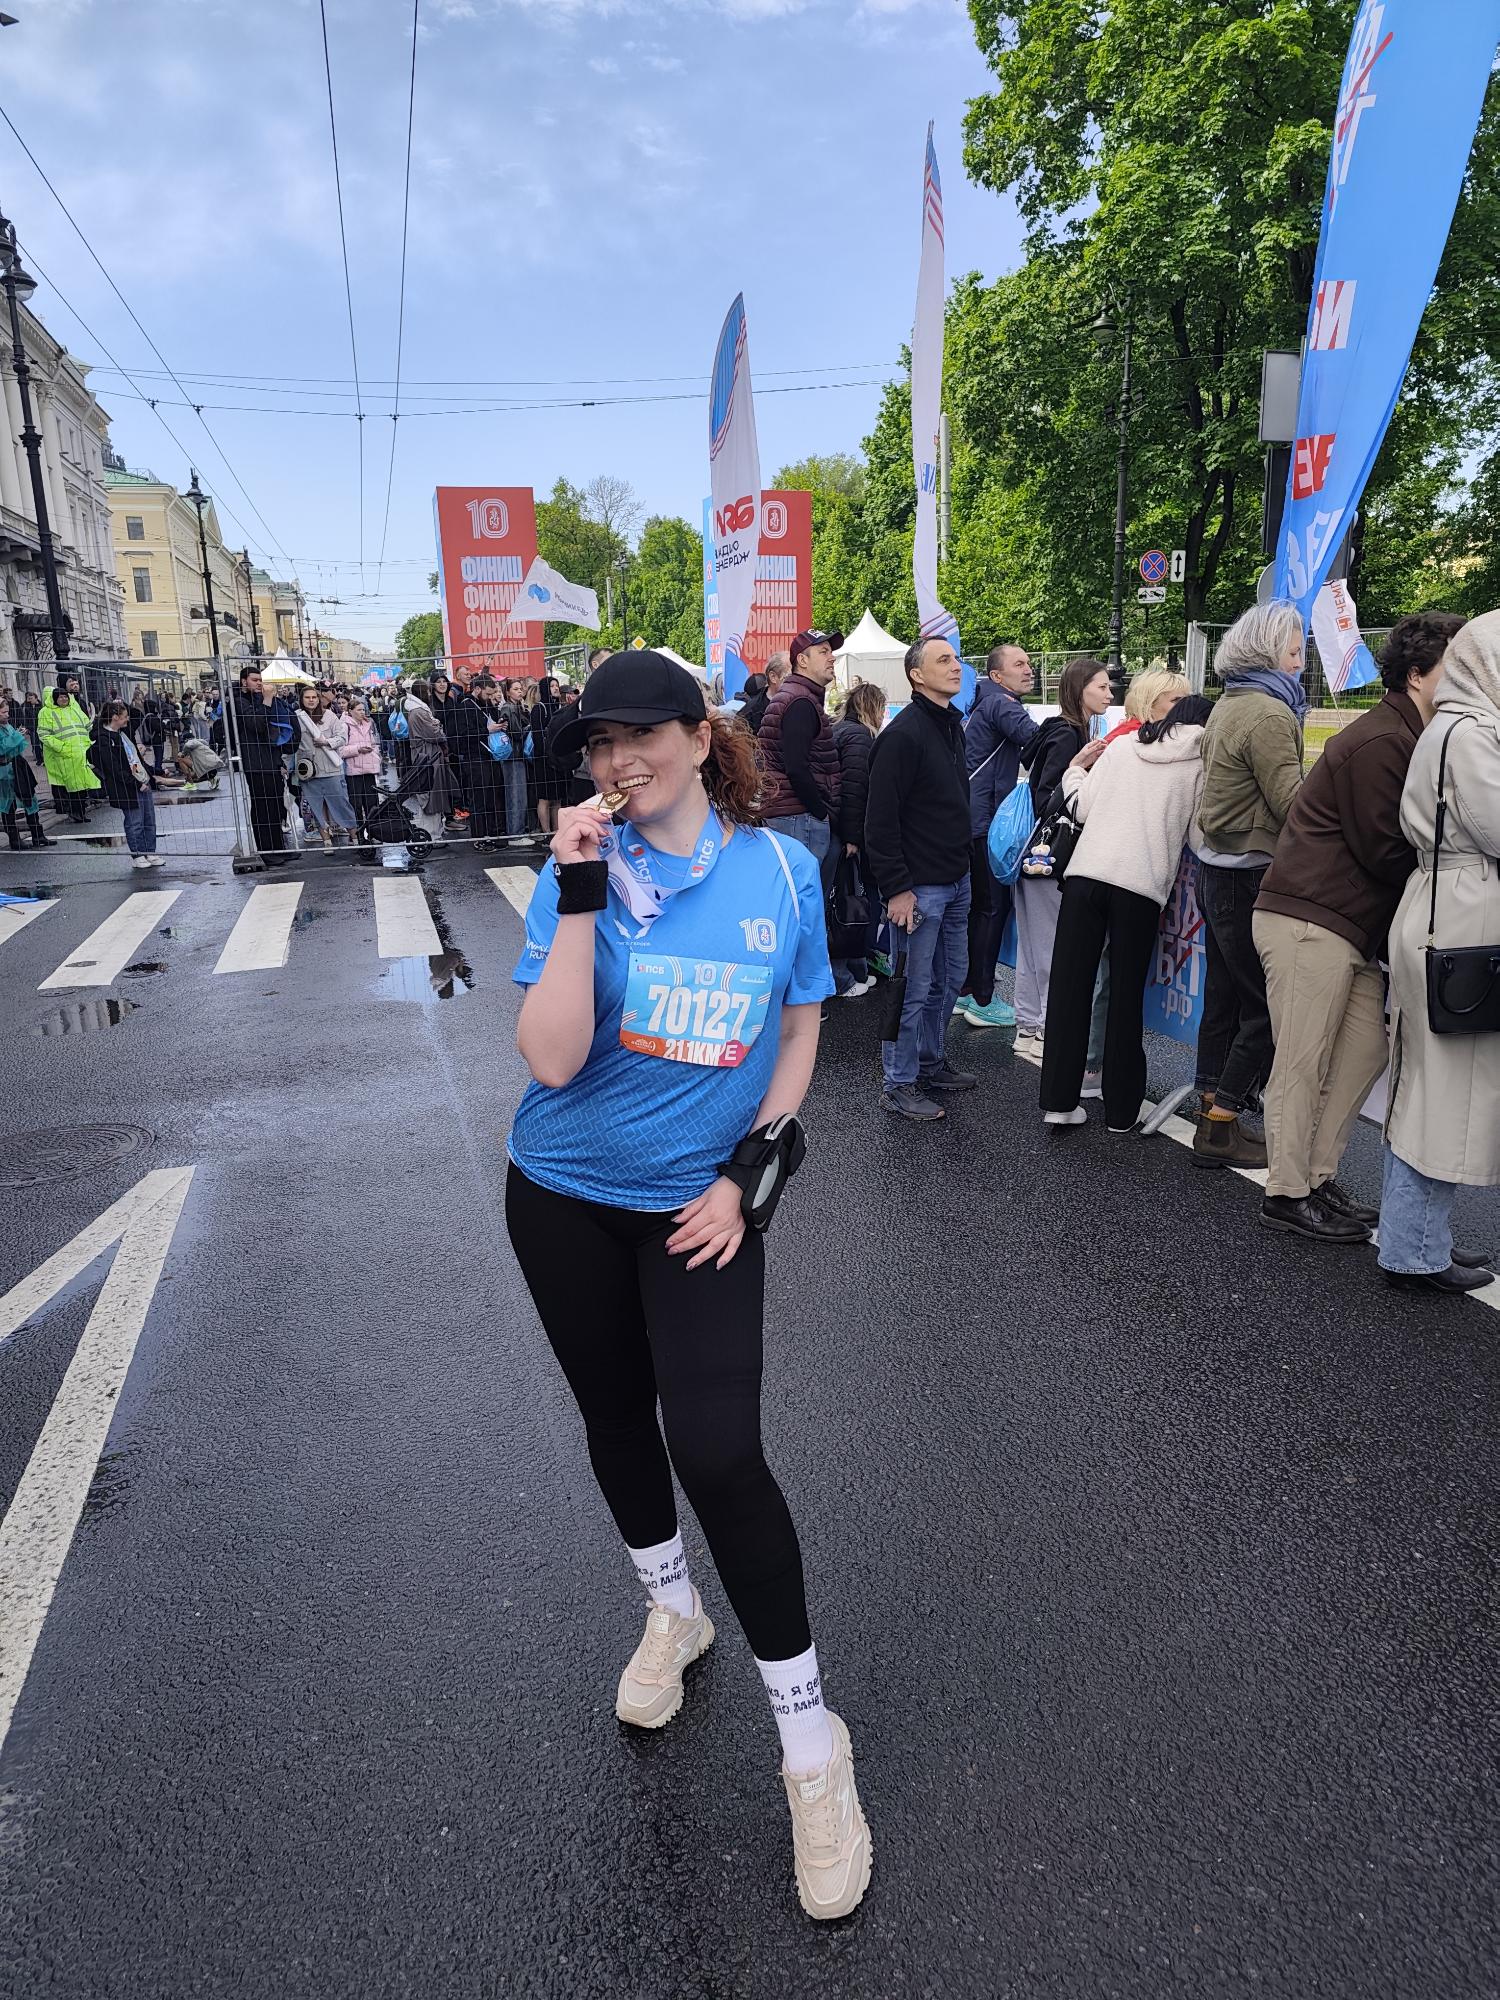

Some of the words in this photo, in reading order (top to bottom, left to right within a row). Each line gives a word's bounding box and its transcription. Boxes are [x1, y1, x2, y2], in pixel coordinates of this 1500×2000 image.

[465, 498, 509, 540] 10
[760, 500, 788, 539] 0
[460, 556, 524, 583] ФИНИШ
[755, 555, 798, 581] ИНИШ
[751, 581, 798, 608] ИНИШ
[699, 838, 715, 866] ПСБ
[738, 917, 777, 953] 10
[645, 964, 665, 975] ПСБ
[694, 963, 717, 986] 10
[647, 984, 752, 1042] 70127
[724, 1044, 738, 1061] E
[643, 1580, 658, 1590] но
[772, 1704, 790, 1715] но
